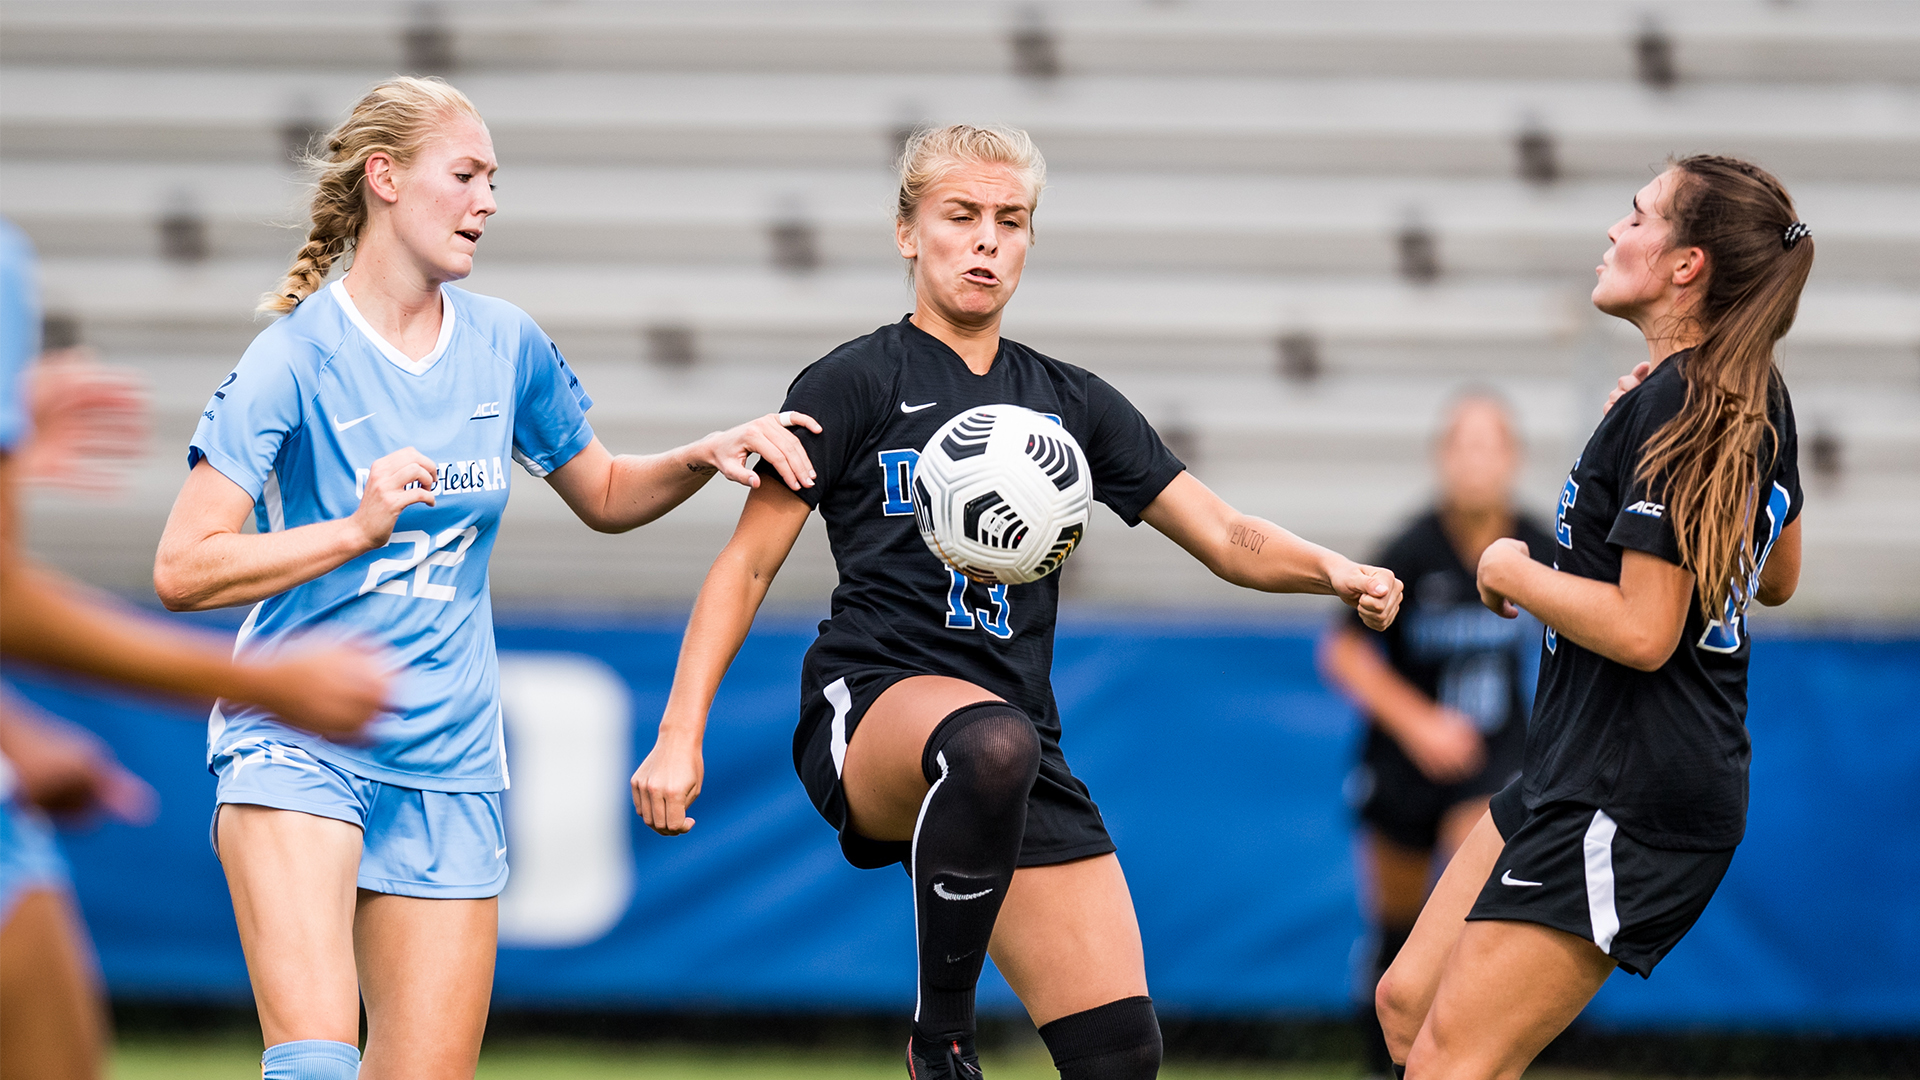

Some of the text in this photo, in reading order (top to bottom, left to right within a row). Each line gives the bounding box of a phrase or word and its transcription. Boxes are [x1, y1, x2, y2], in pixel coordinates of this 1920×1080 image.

[471, 402, 500, 417] ACC
[1625, 500, 1665, 518] ACC
[1230, 524, 1269, 555] ENJOY
[358, 525, 479, 602] 22
[944, 565, 1014, 639] 13
